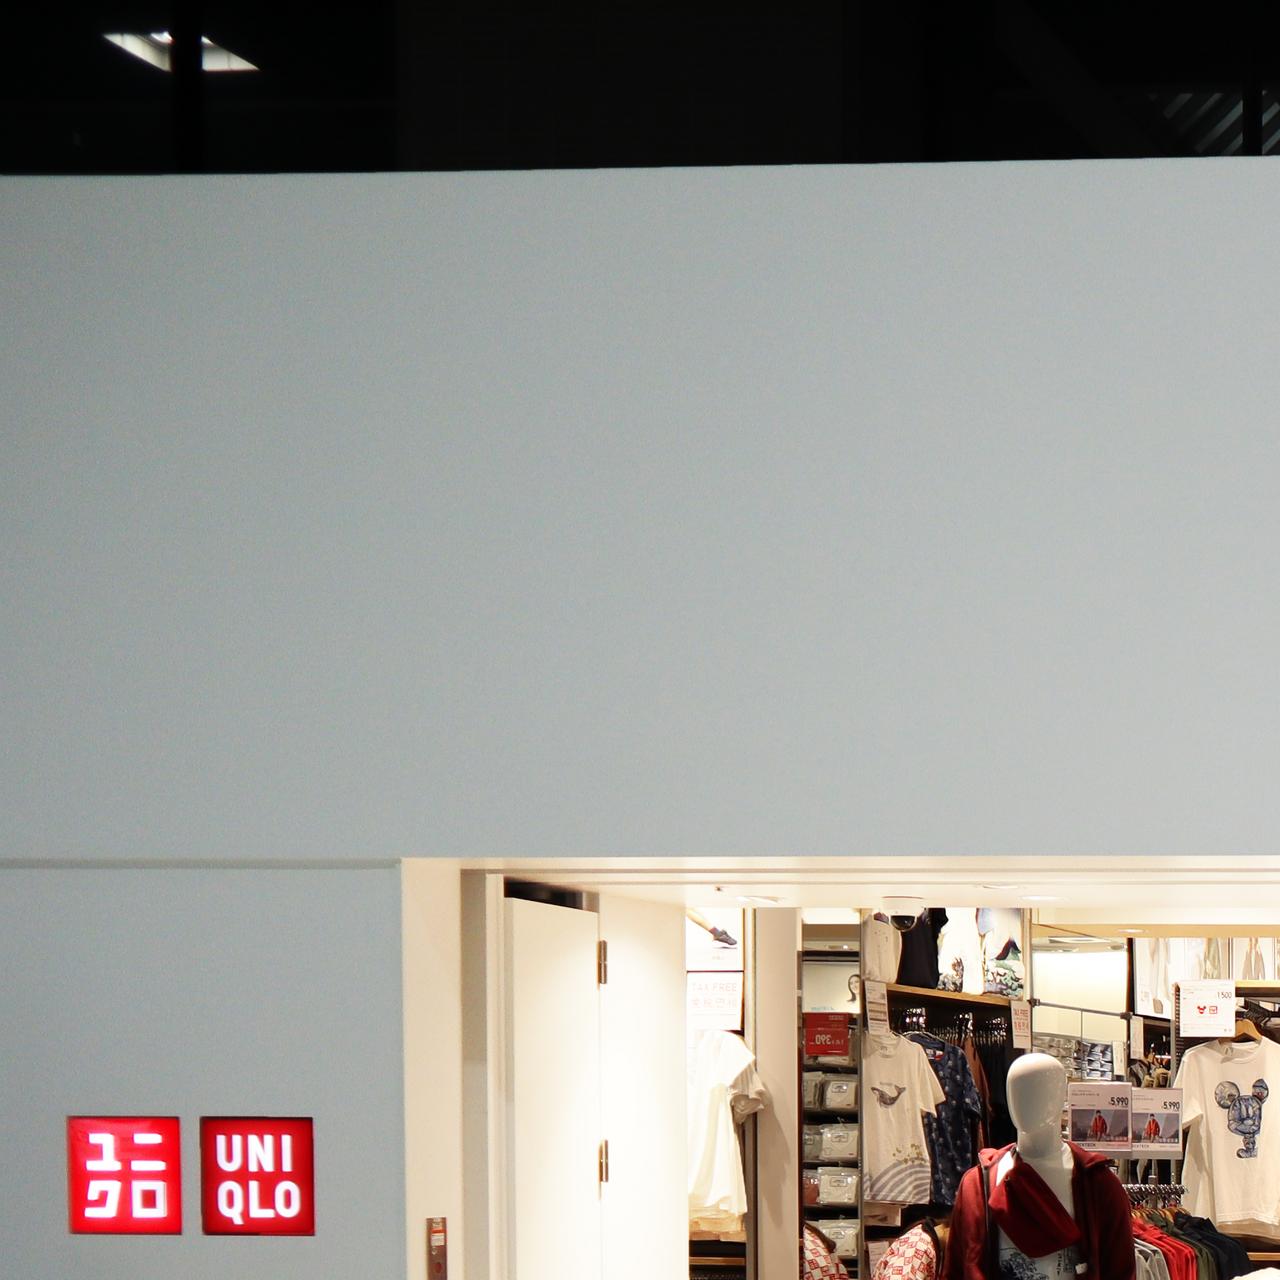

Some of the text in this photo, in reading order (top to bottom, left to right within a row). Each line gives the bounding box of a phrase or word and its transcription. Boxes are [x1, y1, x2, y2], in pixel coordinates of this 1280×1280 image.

[712, 982, 737, 992] FREE
[86, 1133, 166, 1171] ユニ
[216, 1134, 292, 1172] UNI
[85, 1181, 167, 1218] クロ
[217, 1181, 301, 1224] QLO
